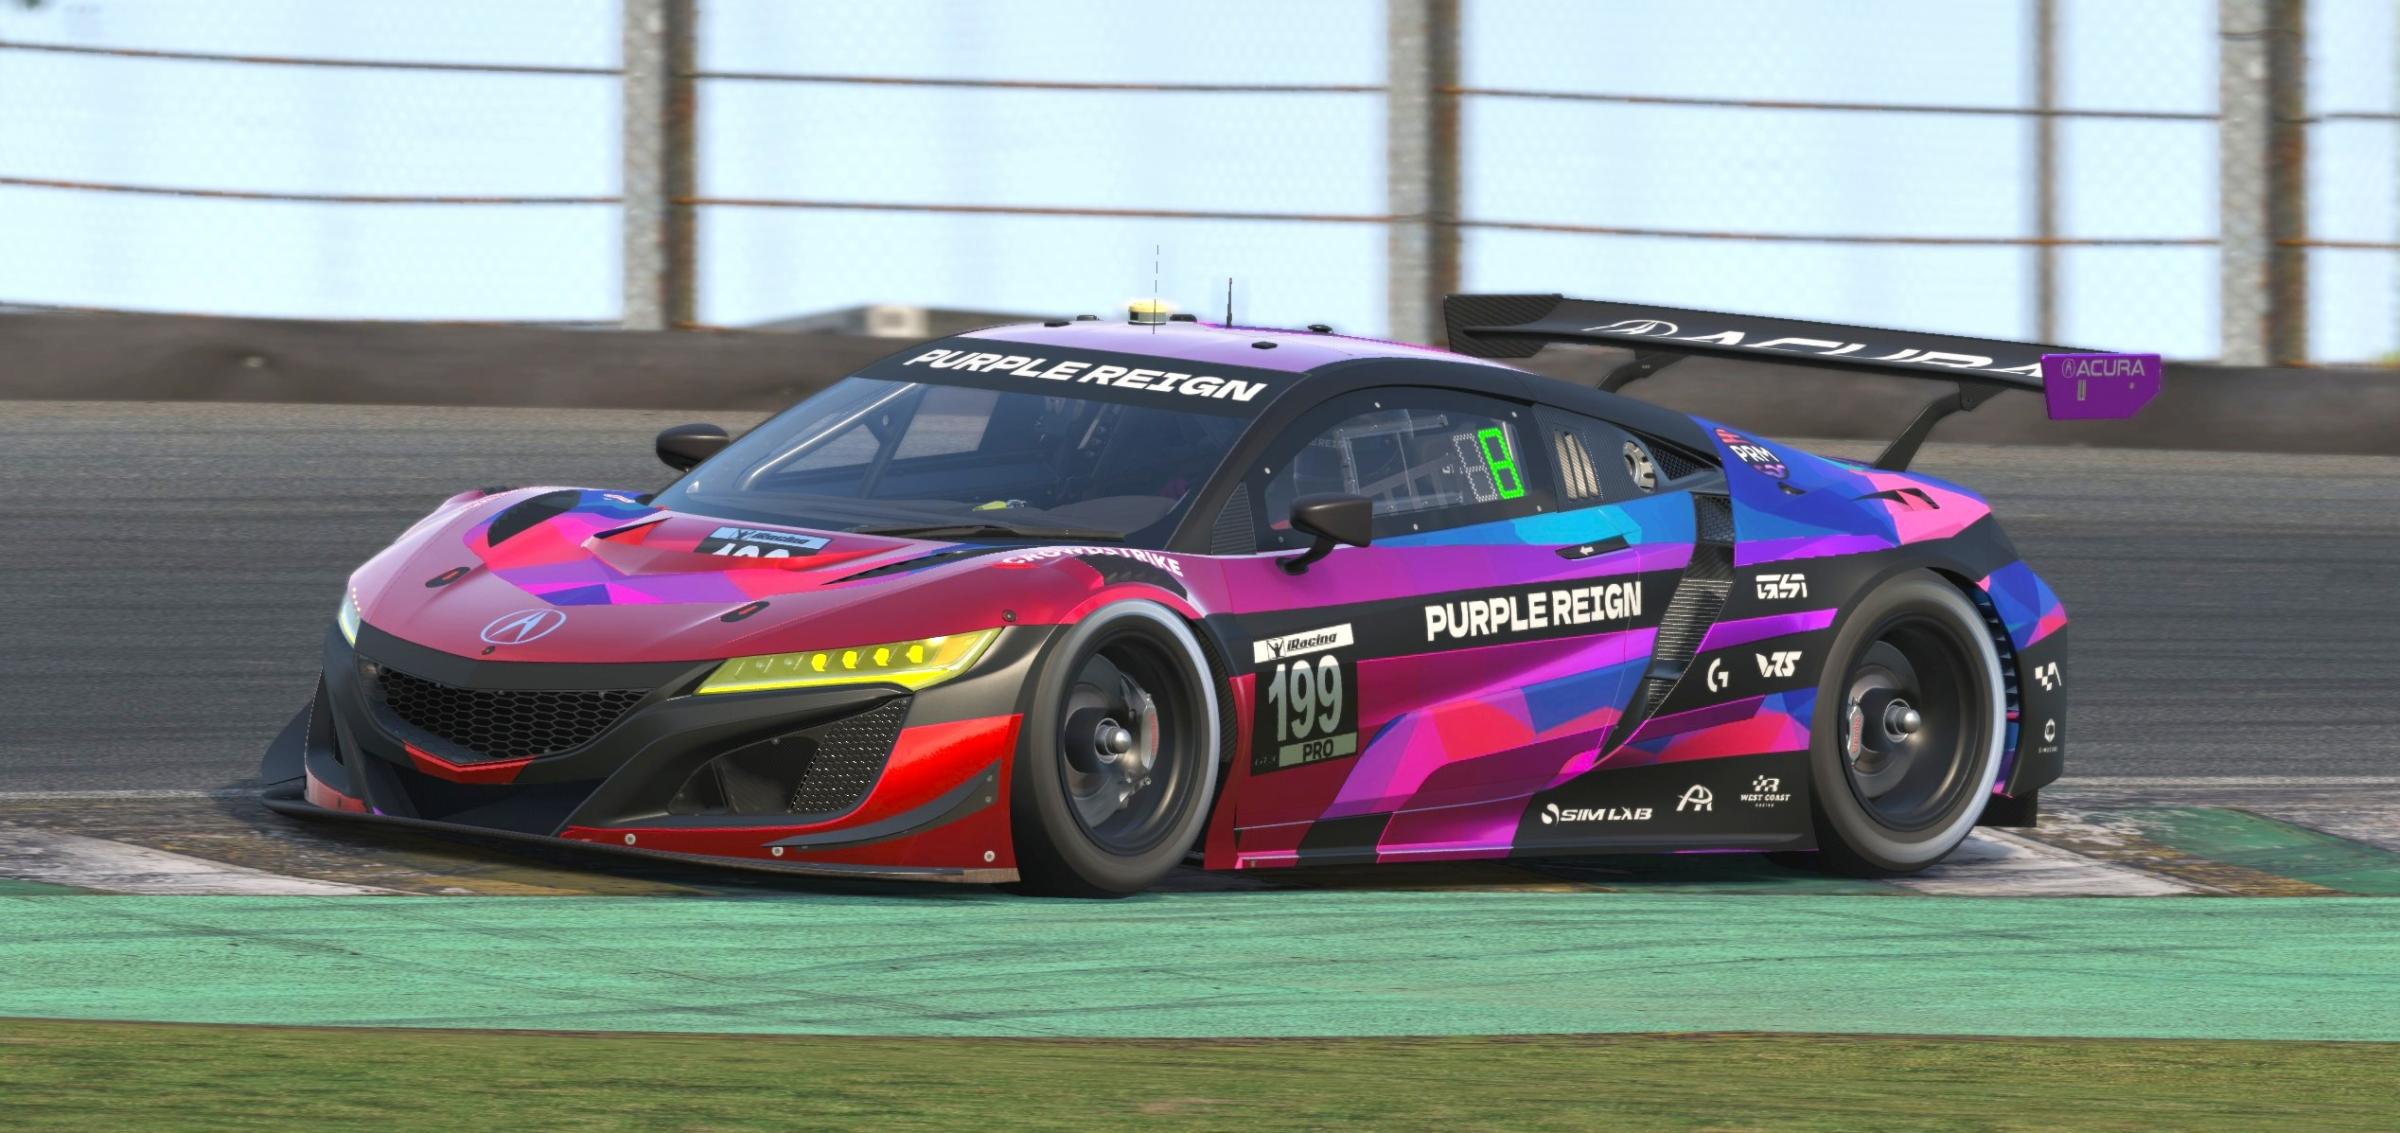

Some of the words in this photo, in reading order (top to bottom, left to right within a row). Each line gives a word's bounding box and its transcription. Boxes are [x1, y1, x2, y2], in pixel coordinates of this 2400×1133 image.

[903, 349, 1092, 381] PURPLE
[1080, 366, 1268, 402] REIGN
[2076, 359, 2146, 377] ACURA
[1729, 445, 1780, 462] PRM
[1425, 592, 1548, 642] PURPLE
[1552, 581, 1642, 626] REIGN
[1287, 633, 1338, 652] iRacing
[1268, 654, 1343, 742] 199
[1302, 739, 1335, 762] PRO
[1560, 808, 1605, 822] SIM
[1607, 807, 1653, 821] LAB
